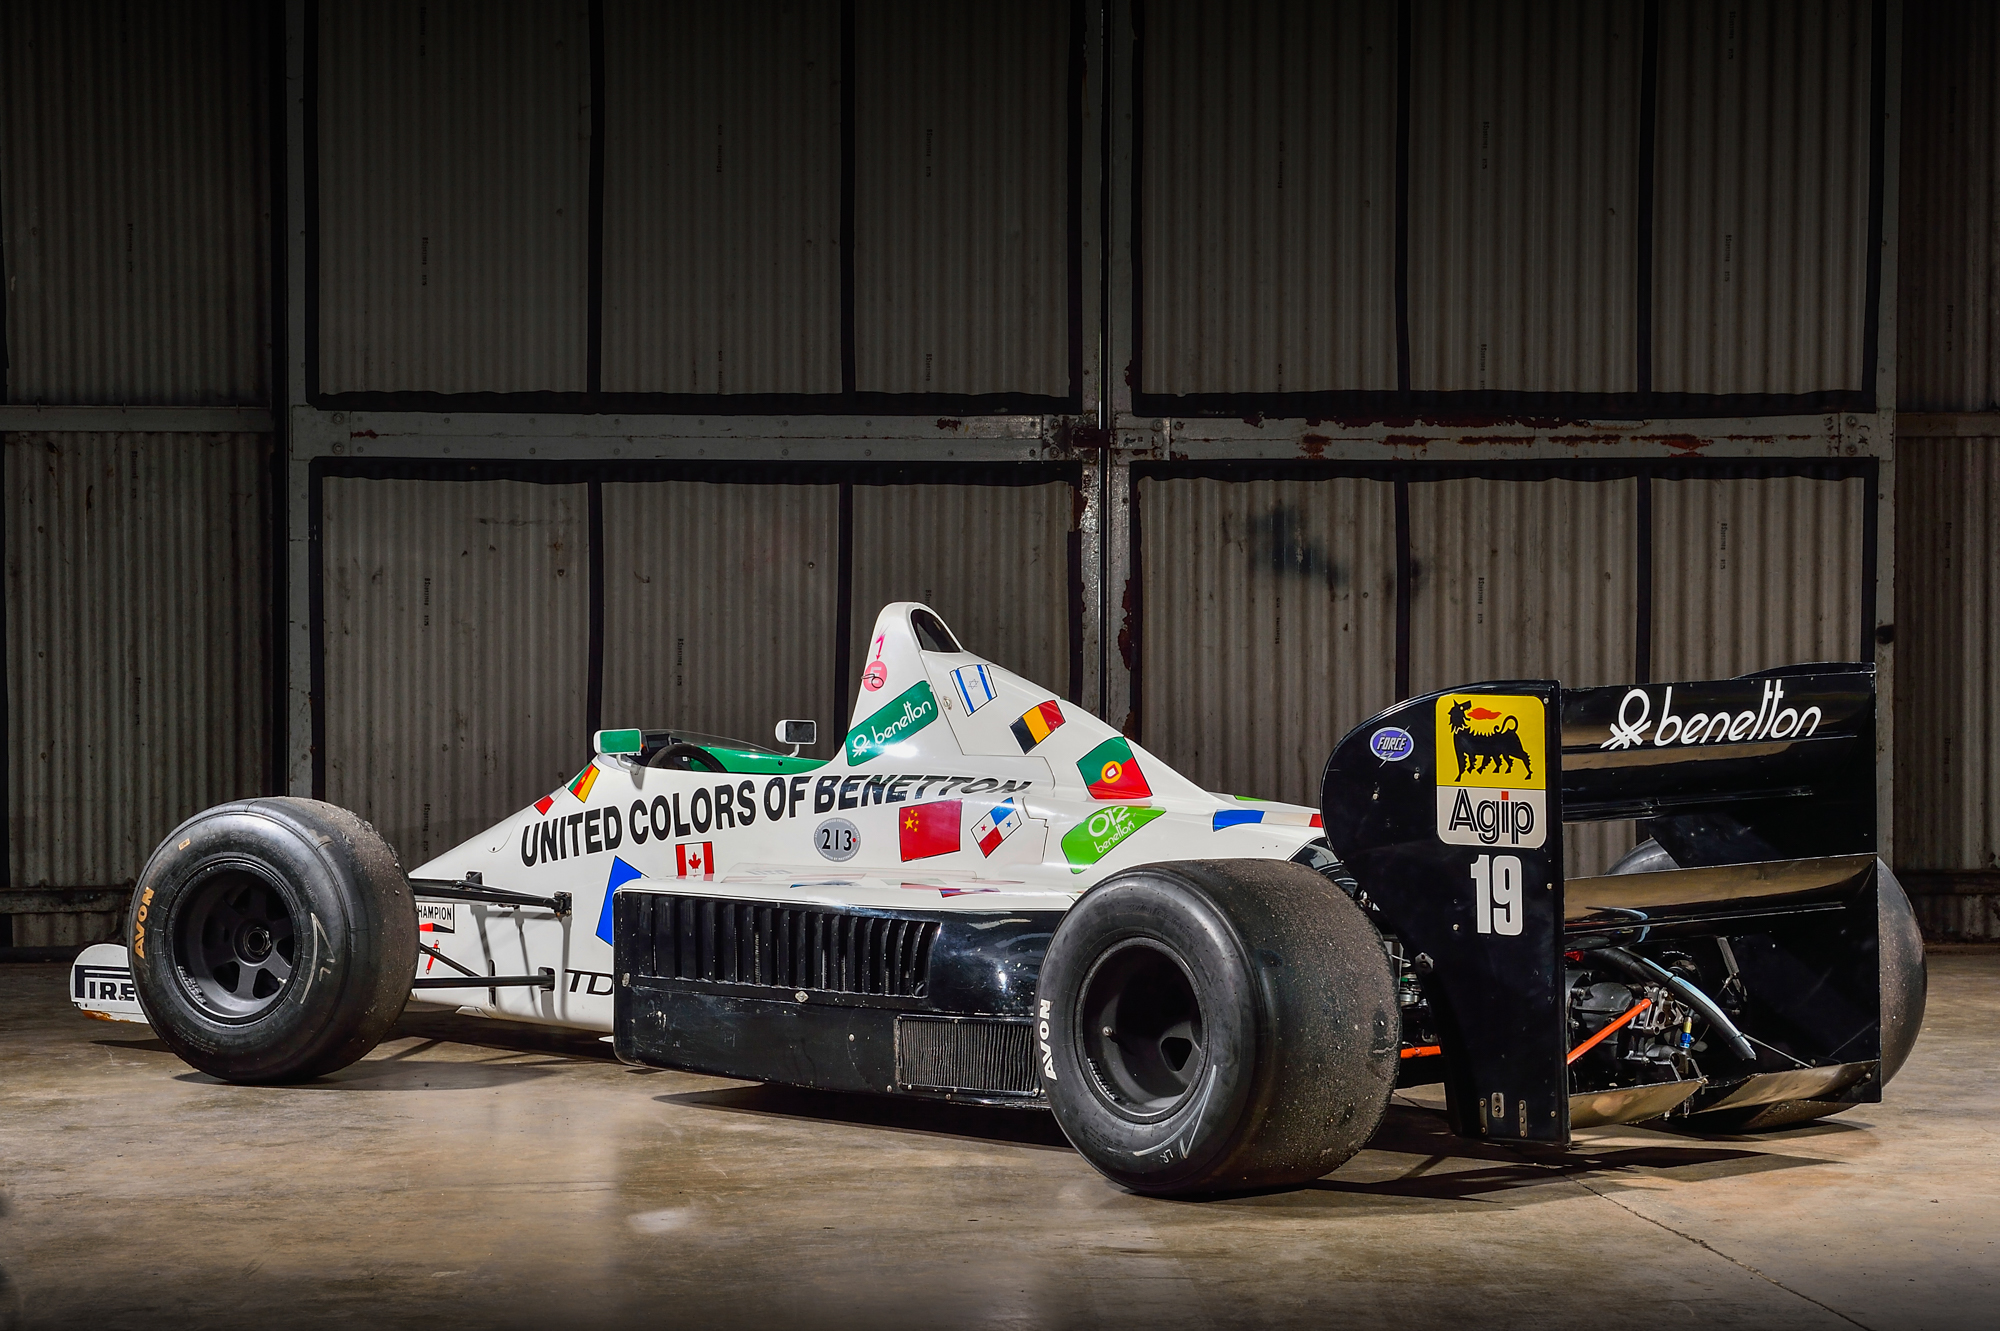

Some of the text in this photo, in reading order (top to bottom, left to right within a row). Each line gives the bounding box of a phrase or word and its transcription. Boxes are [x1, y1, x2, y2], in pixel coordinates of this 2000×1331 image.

[871, 701, 932, 744] benetton
[1376, 736, 1407, 751] FORCE
[1654, 679, 1822, 747] benetton
[521, 774, 1033, 867] UNITED COLORS OF BENETTON
[821, 828, 852, 851] 213
[1093, 820, 1135, 854] benetton
[1448, 788, 1535, 844] Agip
[135, 886, 155, 959] AVON
[1470, 854, 1523, 936] 19
[1039, 999, 1057, 1081] AVON
